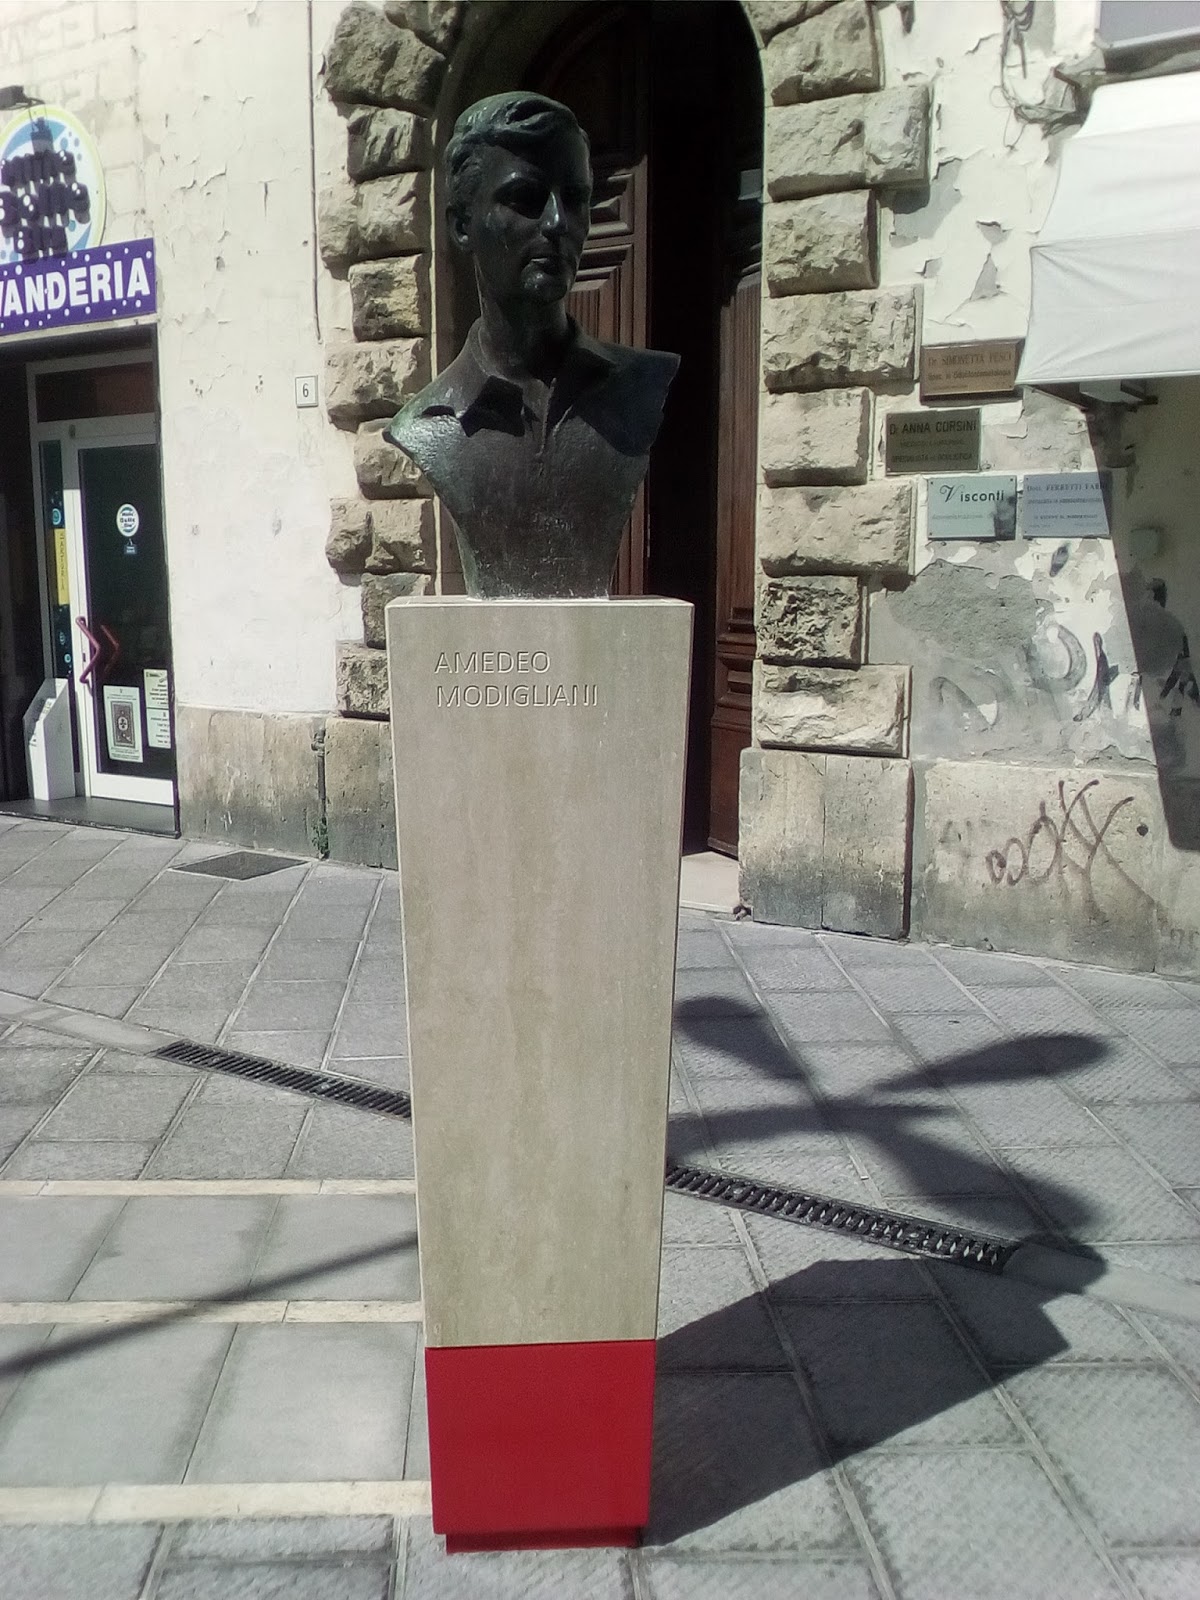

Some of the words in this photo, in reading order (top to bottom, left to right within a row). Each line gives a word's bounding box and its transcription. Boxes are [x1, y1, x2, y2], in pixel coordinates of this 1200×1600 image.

[0, 257, 151, 318] ANDERIA
[302, 382, 309, 398] 6
[902, 422, 931, 433] ANNA
[936, 420, 976, 432] CORSINI
[940, 484, 1005, 502] Visconti
[434, 651, 551, 674] AMEDEO
[437, 684, 599, 708] MODIGLIANI
